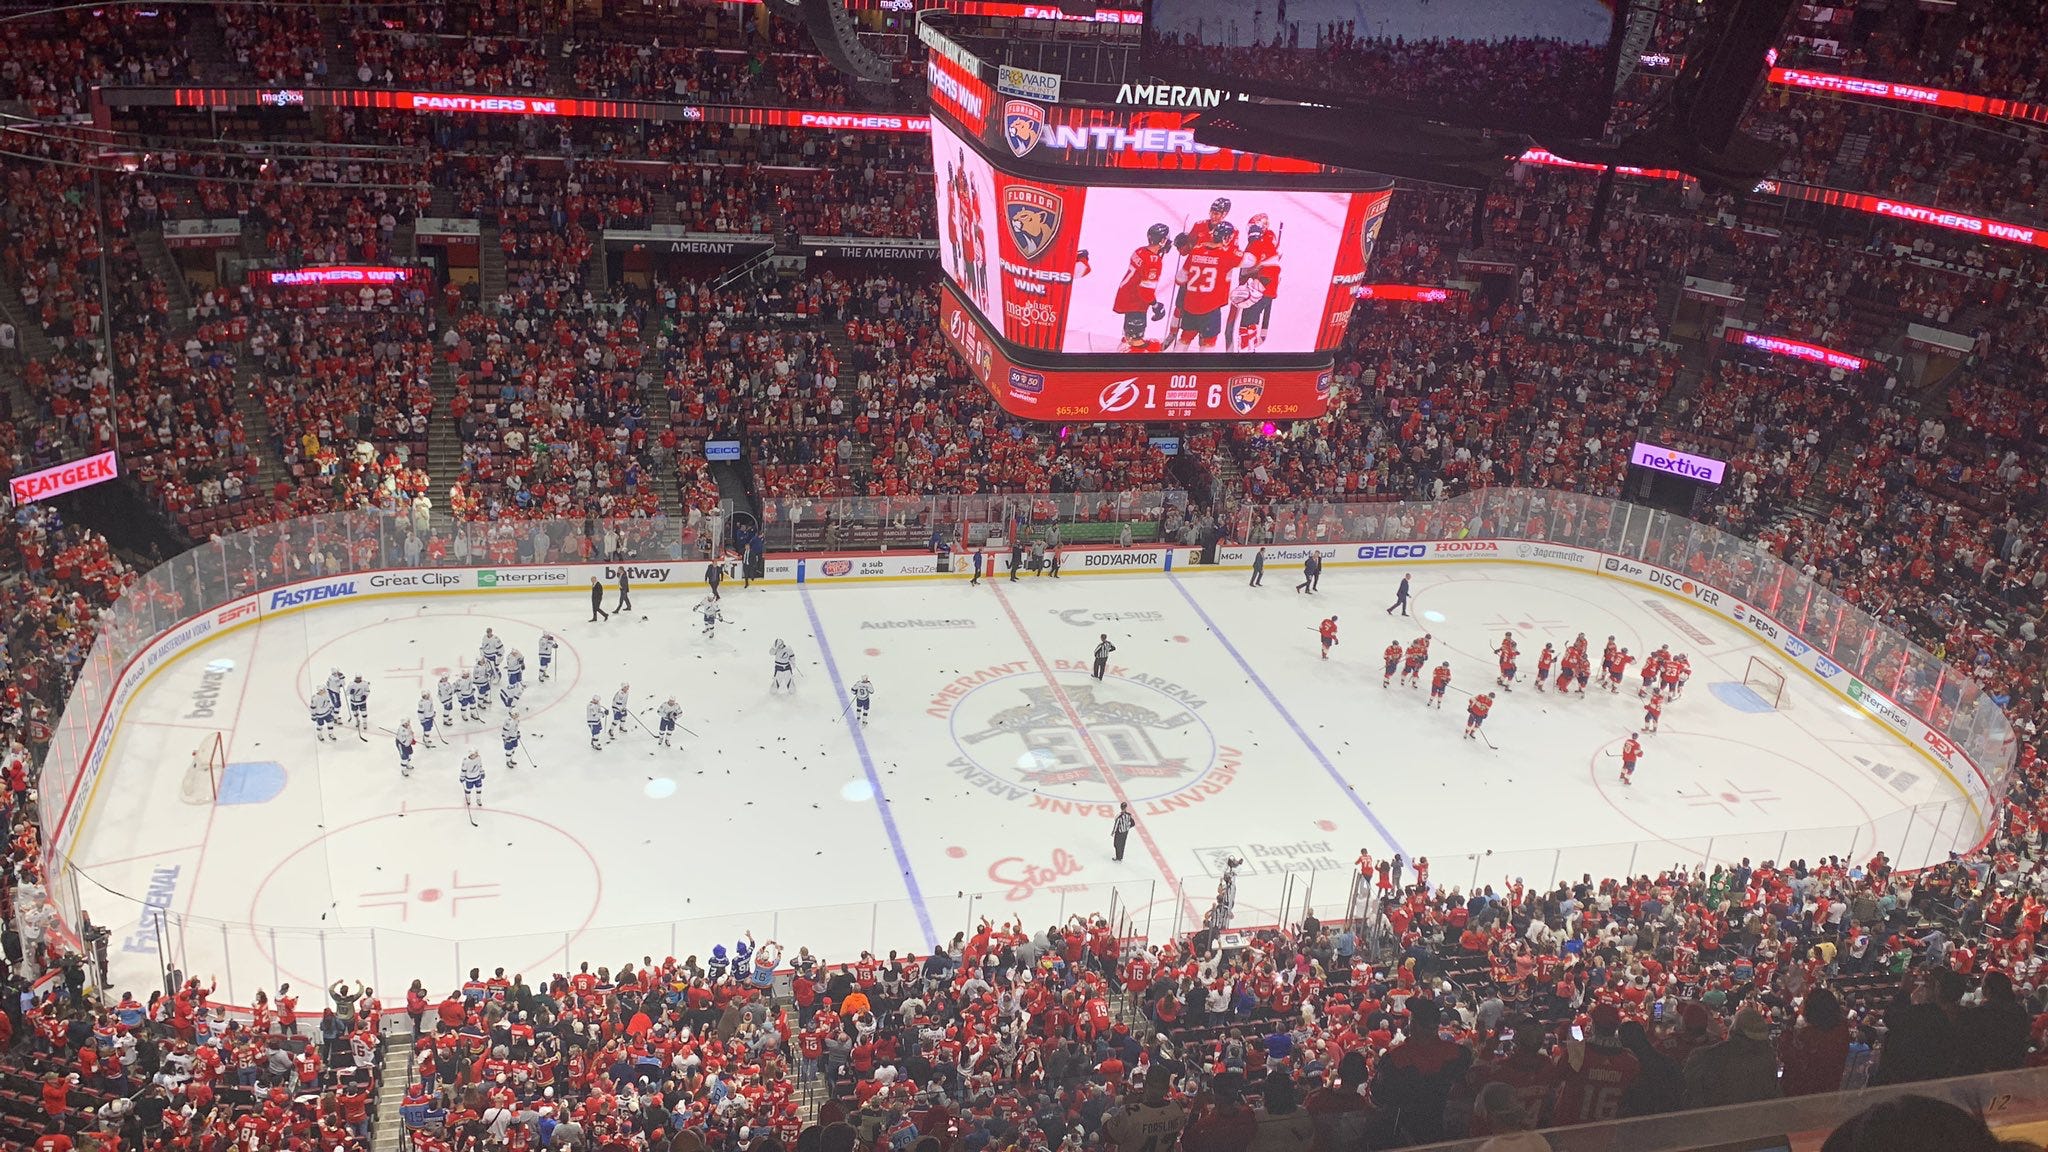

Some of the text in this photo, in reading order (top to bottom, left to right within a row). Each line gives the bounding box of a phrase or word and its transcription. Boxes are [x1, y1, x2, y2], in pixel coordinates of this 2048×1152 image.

[1000, 67, 1057, 89] BROWARD
[1784, 71, 1889, 95] PANTHERS
[928, 62, 982, 119] THERS WIN!
[1023, 85, 1056, 95] COUNTY
[1115, 84, 1230, 107] AMERAN
[413, 96, 526, 110] PANTHERS
[1008, 105, 1040, 118] FLORIDA
[802, 114, 902, 128] PANTHERS
[1042, 124, 1220, 153] ANTHER
[1008, 191, 1053, 208] FLORIDA
[1877, 202, 2033, 243] PANTHERS WIN!
[671, 242, 734, 255] AMERANT
[841, 247, 862, 258] THE
[865, 248, 924, 259] AMERANT
[272, 271, 363, 283] PANTHERS
[1000, 258, 1072, 281] PANTHERS
[1014, 278, 1046, 294] WIN!
[1187, 266, 1218, 292] 23
[1006, 300, 1056, 326] magoos
[1745, 335, 1825, 360] PANTHERS
[1170, 375, 1198, 389] 00.0
[1234, 378, 1264, 386] FLORIDA
[1144, 384, 1156, 409] 1
[1207, 384, 1223, 409] 6
[1056, 406, 1089, 416] $65,340
[1267, 405, 1298, 414] $65,340
[706, 446, 740, 455] GEICO
[1642, 453, 1712, 480] nextiva
[14, 455, 115, 498] SEATGEEK
[1277, 548, 1336, 560] MassMual
[1357, 545, 1427, 559] GEICO
[1435, 542, 1498, 551] HONDA
[869, 560, 883, 568] sub
[1085, 553, 1158, 566] BODYARMOR
[370, 572, 460, 587] Great Clips
[481, 571, 567, 584] enterprise
[270, 581, 357, 610] FASTENAL
[1649, 570, 1720, 606] DISCOVER
[217, 601, 257, 624] ESPN
[1093, 609, 1163, 621] CELSIUS
[860, 618, 975, 630] AutoNation
[1748, 613, 1778, 640] PEPSI
[1666, 667, 1677, 676] 23
[926, 661, 1028, 719] AMERANT
[1131, 672, 1207, 709] ARENA
[1849, 683, 1908, 728] enterprise
[92, 713, 115, 775] GEICO
[1924, 731, 1955, 760] DEX
[946, 745, 1243, 817] AMERANT BANK ARENA
[1249, 839, 1334, 858] Baptist
[988, 848, 1084, 901] Stoli
[1258, 855, 1342, 877] Health
[123, 865, 181, 955] FASTENAL
[1132, 969, 1143, 981] 16
[1096, 1006, 1107, 1017] 19
[303, 1063, 314, 1073] 19
[1989, 1095, 2011, 1112] 12
